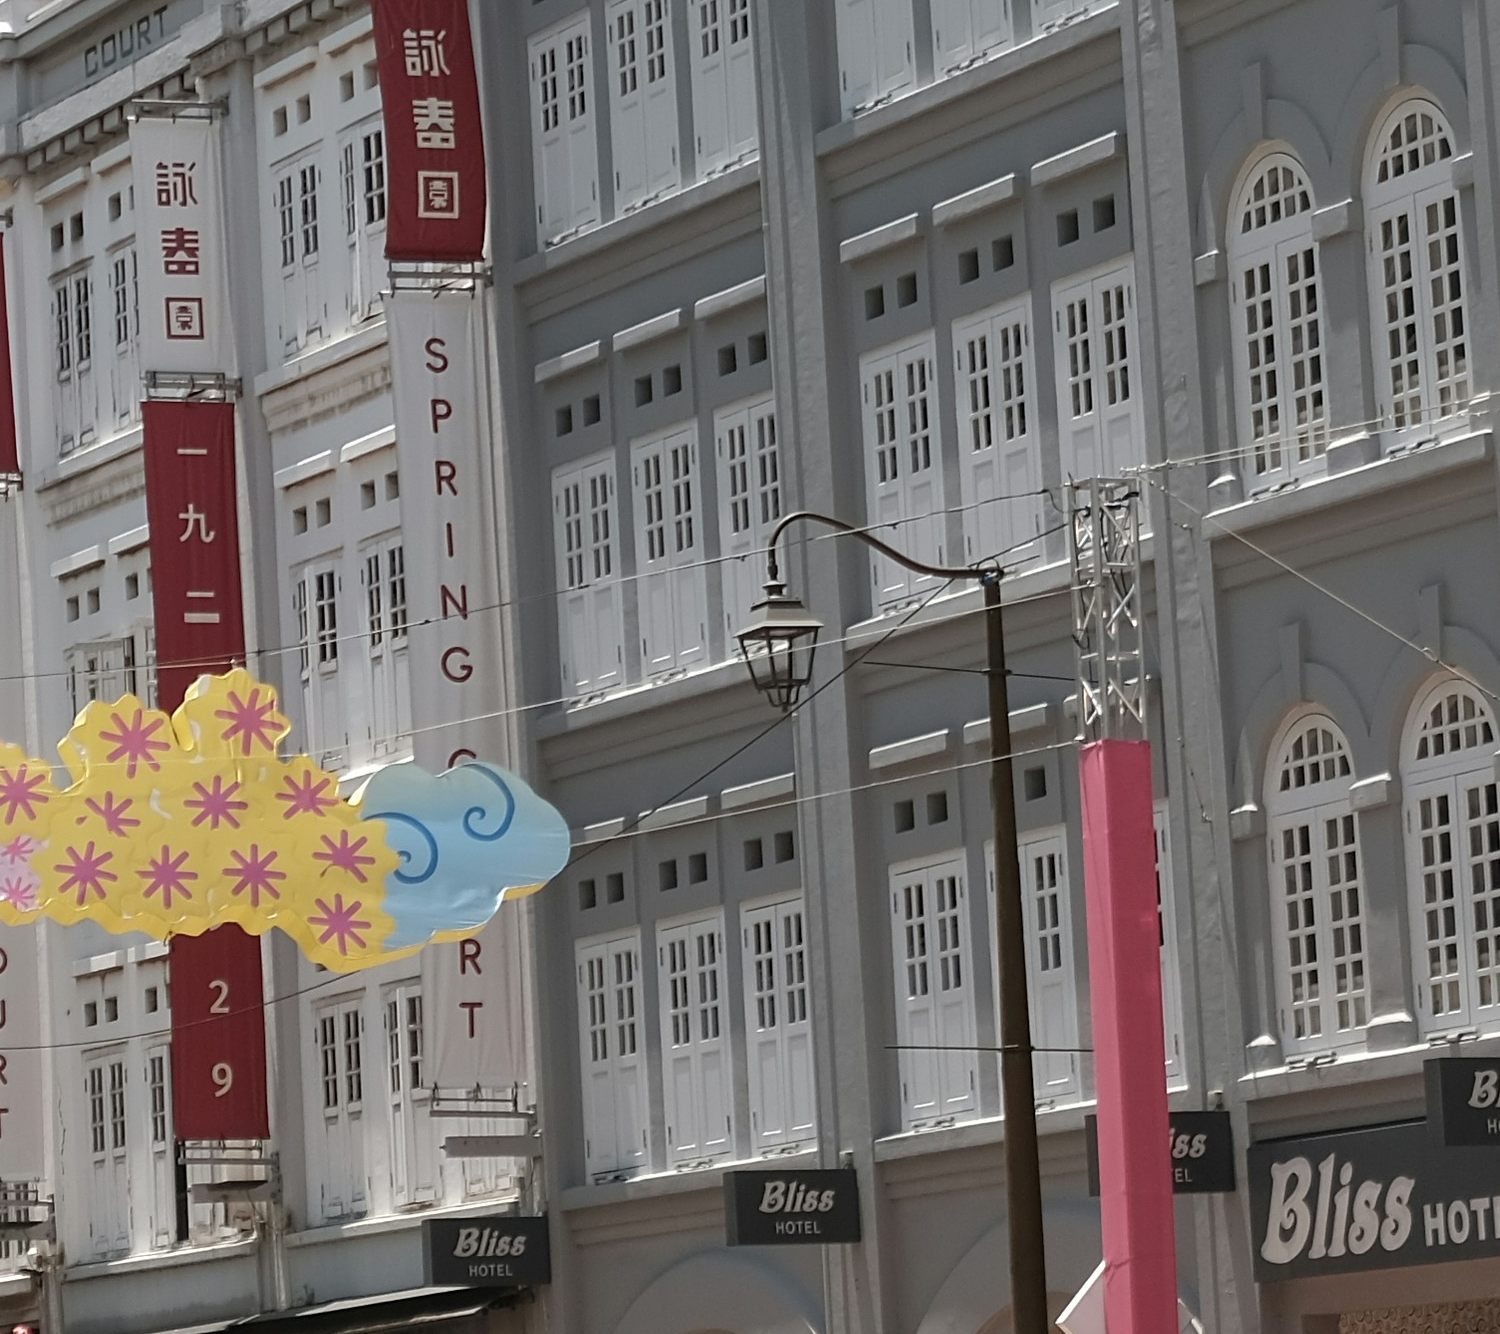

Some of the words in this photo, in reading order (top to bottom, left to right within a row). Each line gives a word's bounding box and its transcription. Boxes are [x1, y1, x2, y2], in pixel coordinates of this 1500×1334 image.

[84, 4, 169, 79] COURT
[176, 447, 222, 624] 一九二
[425, 337, 474, 684] SPRING
[758, 1180, 836, 1214] Bliss
[1260, 1151, 1416, 1265] Bliss
[453, 1226, 528, 1258] Bliss
[775, 1220, 822, 1235] HOTEL
[468, 1264, 514, 1278] HOTEL
